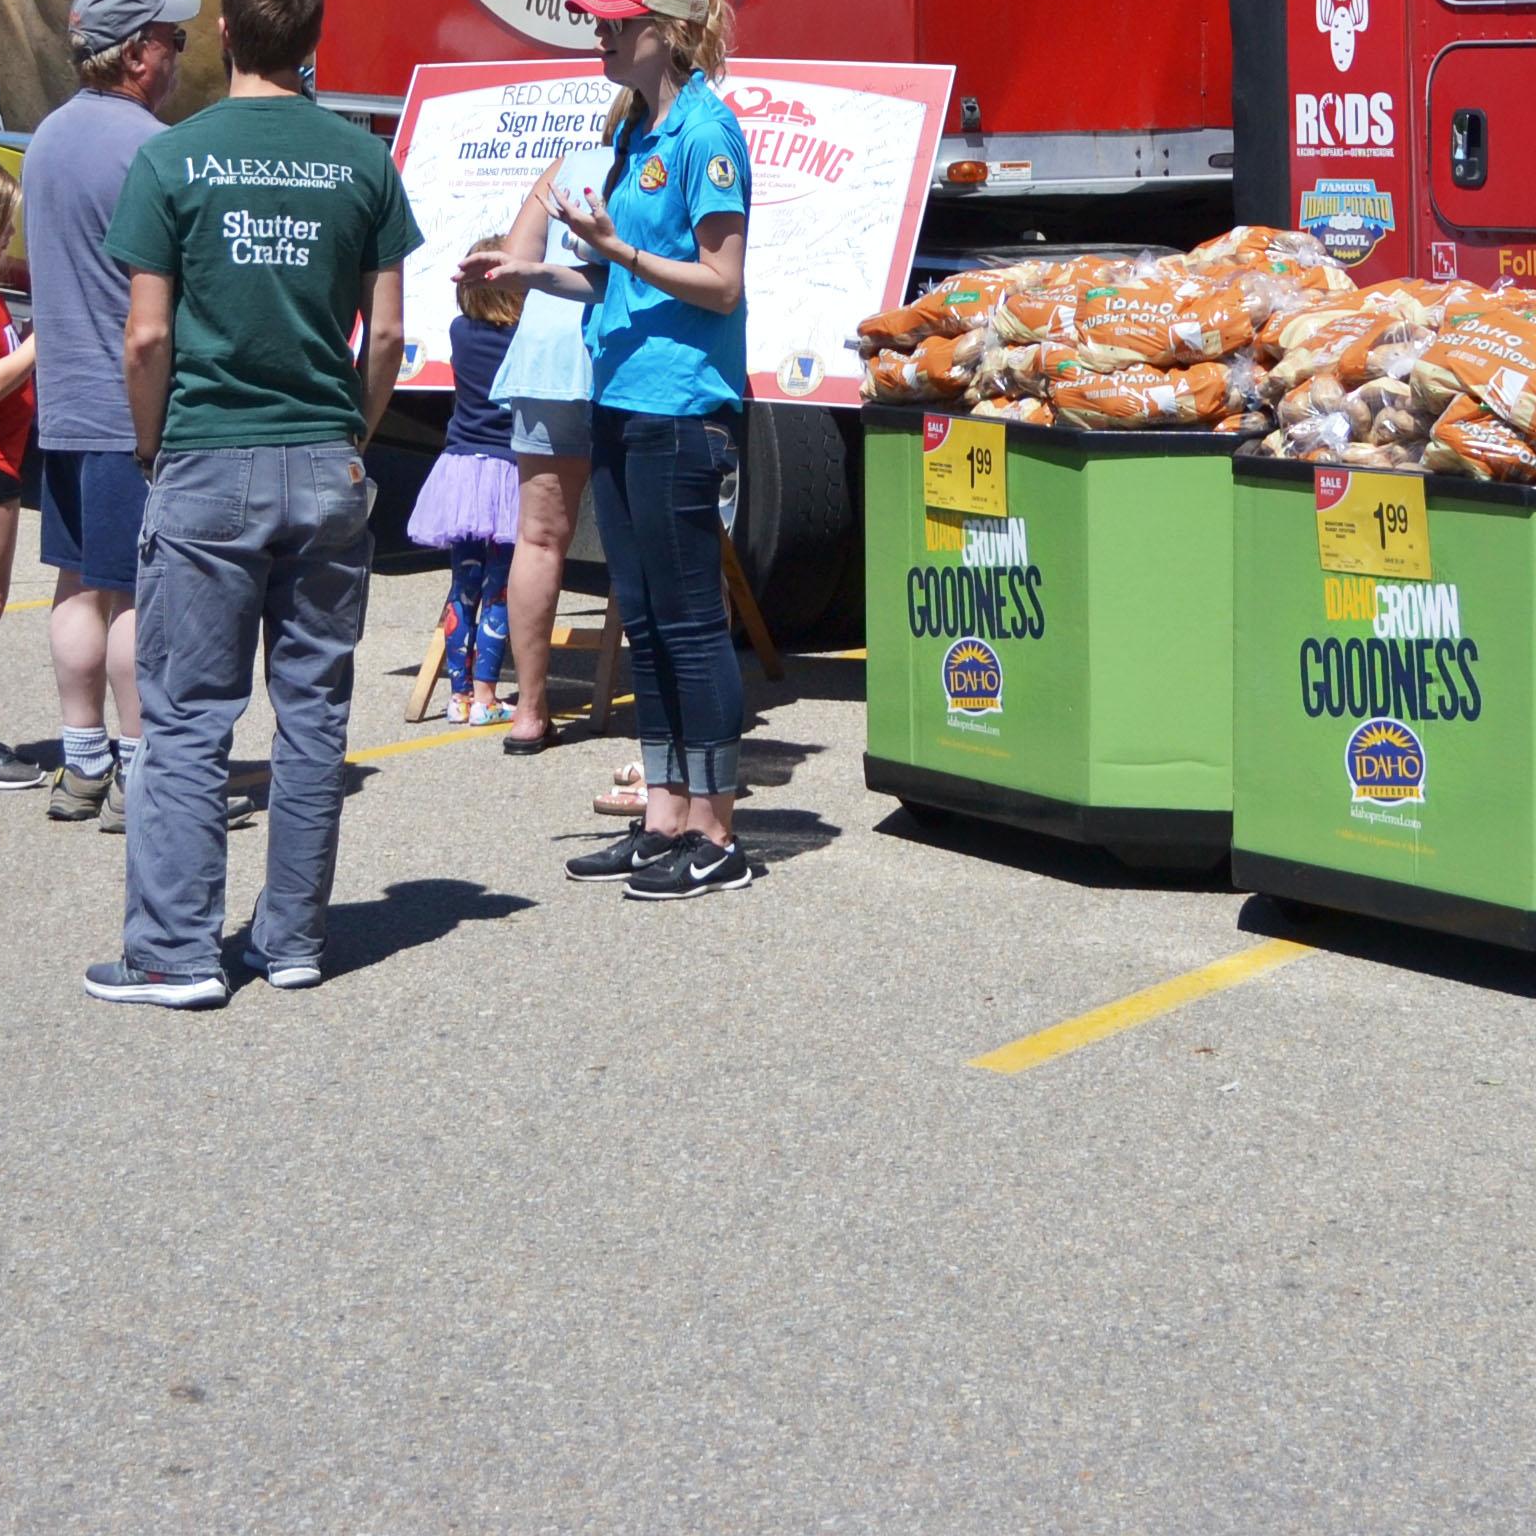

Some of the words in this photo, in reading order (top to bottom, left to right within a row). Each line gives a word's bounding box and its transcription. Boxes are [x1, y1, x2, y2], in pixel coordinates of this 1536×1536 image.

[501, 85, 542, 105] RED
[547, 82, 613, 105] CROSS
[496, 111, 538, 138] Sign
[541, 110, 584, 133] here
[590, 113, 607, 132] to
[1295, 91, 1394, 146] RODS
[458, 137, 510, 160] make
[515, 143, 527, 159] a
[209, 176, 238, 187] FINE
[240, 176, 337, 190] WOODWORKING
[1320, 182, 1371, 193] FAMOUS
[223, 209, 322, 241] Shutter
[231, 237, 310, 267] Crafts
[1324, 233, 1370, 247] BOWL
[1105, 296, 1174, 315] IDAHO
[1457, 318, 1524, 347] IDAHO
[927, 421, 944, 434] SALE
[1319, 476, 1342, 489] SALE
[961, 517, 1028, 567] GROWN
[907, 565, 1045, 640] GOODNESS
[1324, 576, 1376, 621] IDAHO
[1373, 582, 1461, 639] GROWN
[949, 669, 999, 693] IDAHO
[1300, 636, 1482, 722] GOODNESS
[1355, 753, 1421, 781] IDAHO
